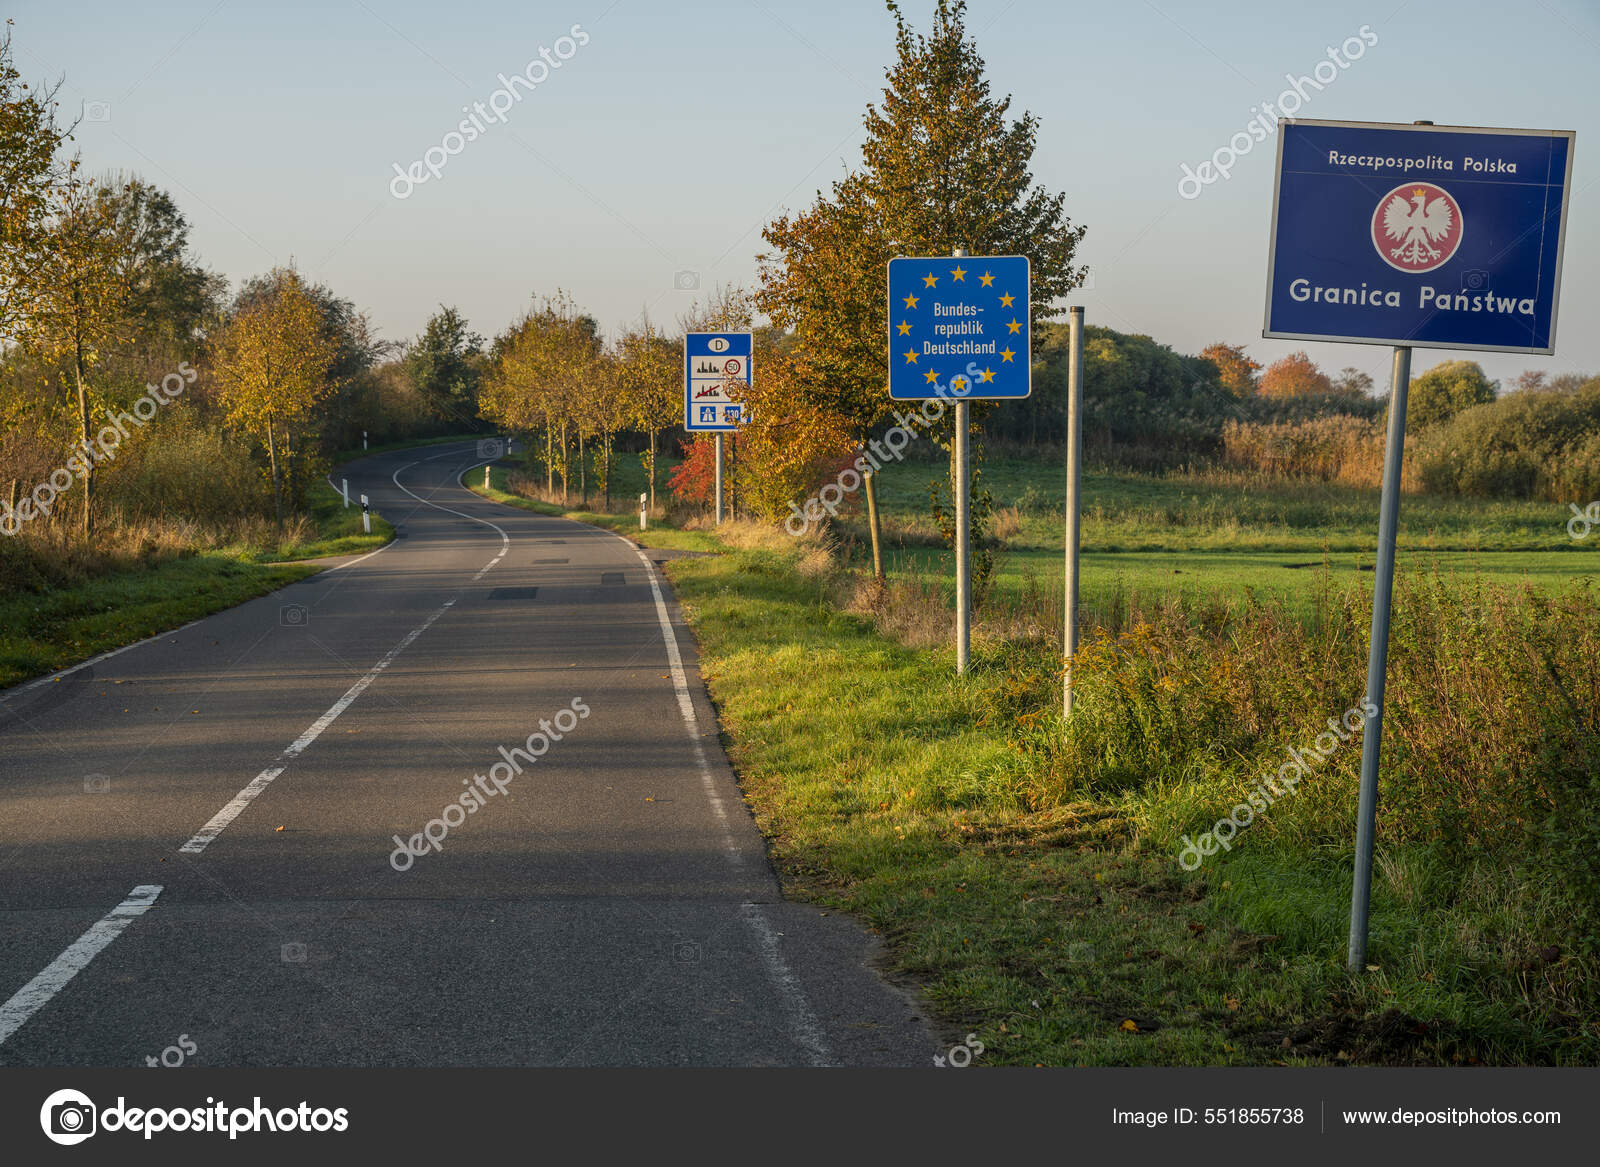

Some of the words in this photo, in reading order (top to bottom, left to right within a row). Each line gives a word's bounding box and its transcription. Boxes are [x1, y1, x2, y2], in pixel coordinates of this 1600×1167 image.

[1328, 150, 1454, 172] Rzeczpospolita
[1463, 157, 1517, 173] Polska
[1289, 278, 1400, 307] Granica
[1419, 286, 1536, 315] Państwa
[933, 302, 985, 317] Bundes-
[934, 321, 984, 338] republik
[715, 340, 723, 350] D
[923, 340, 996, 355] Deutschland
[728, 363, 738, 371] 50
